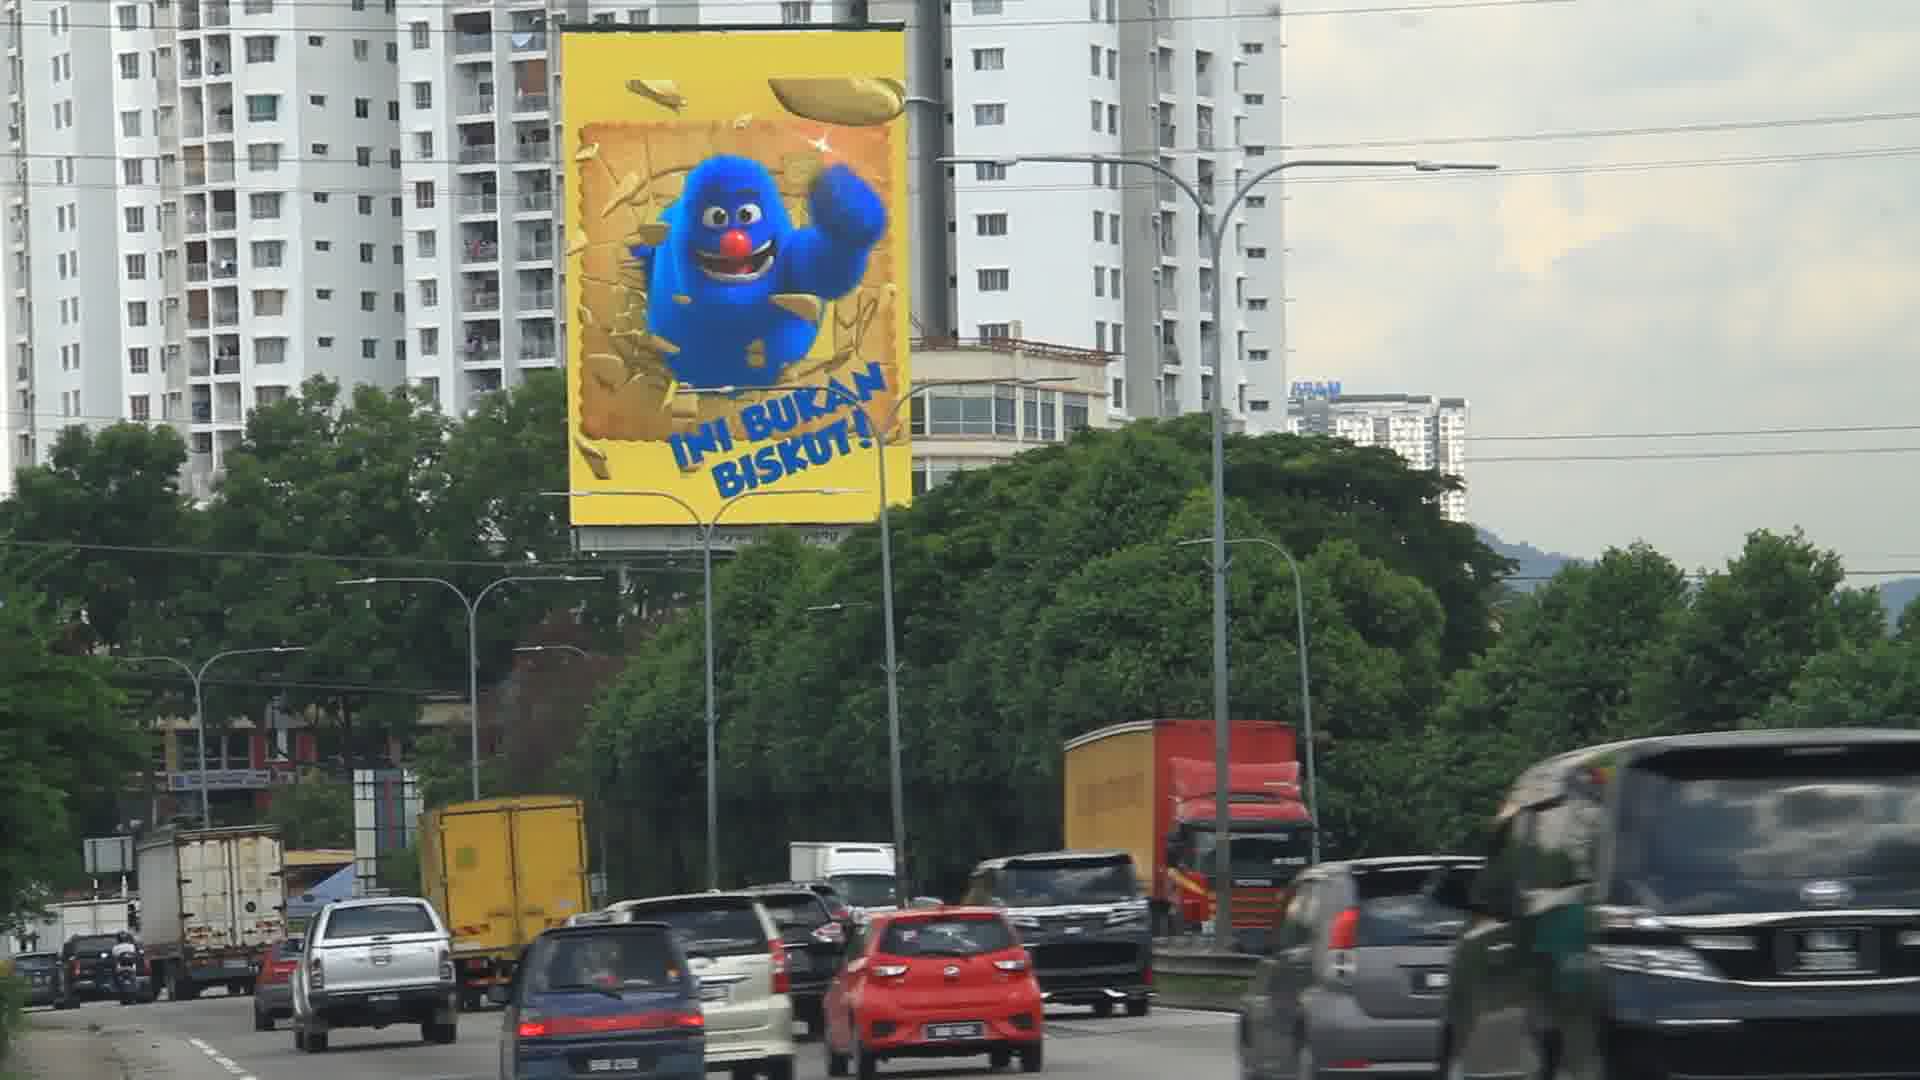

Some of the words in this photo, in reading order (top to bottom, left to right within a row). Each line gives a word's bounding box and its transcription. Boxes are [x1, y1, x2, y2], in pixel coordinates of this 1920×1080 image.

[668, 416, 734, 469] INI
[740, 361, 885, 442] BUKAN
[711, 407, 872, 498] BISKUT!
